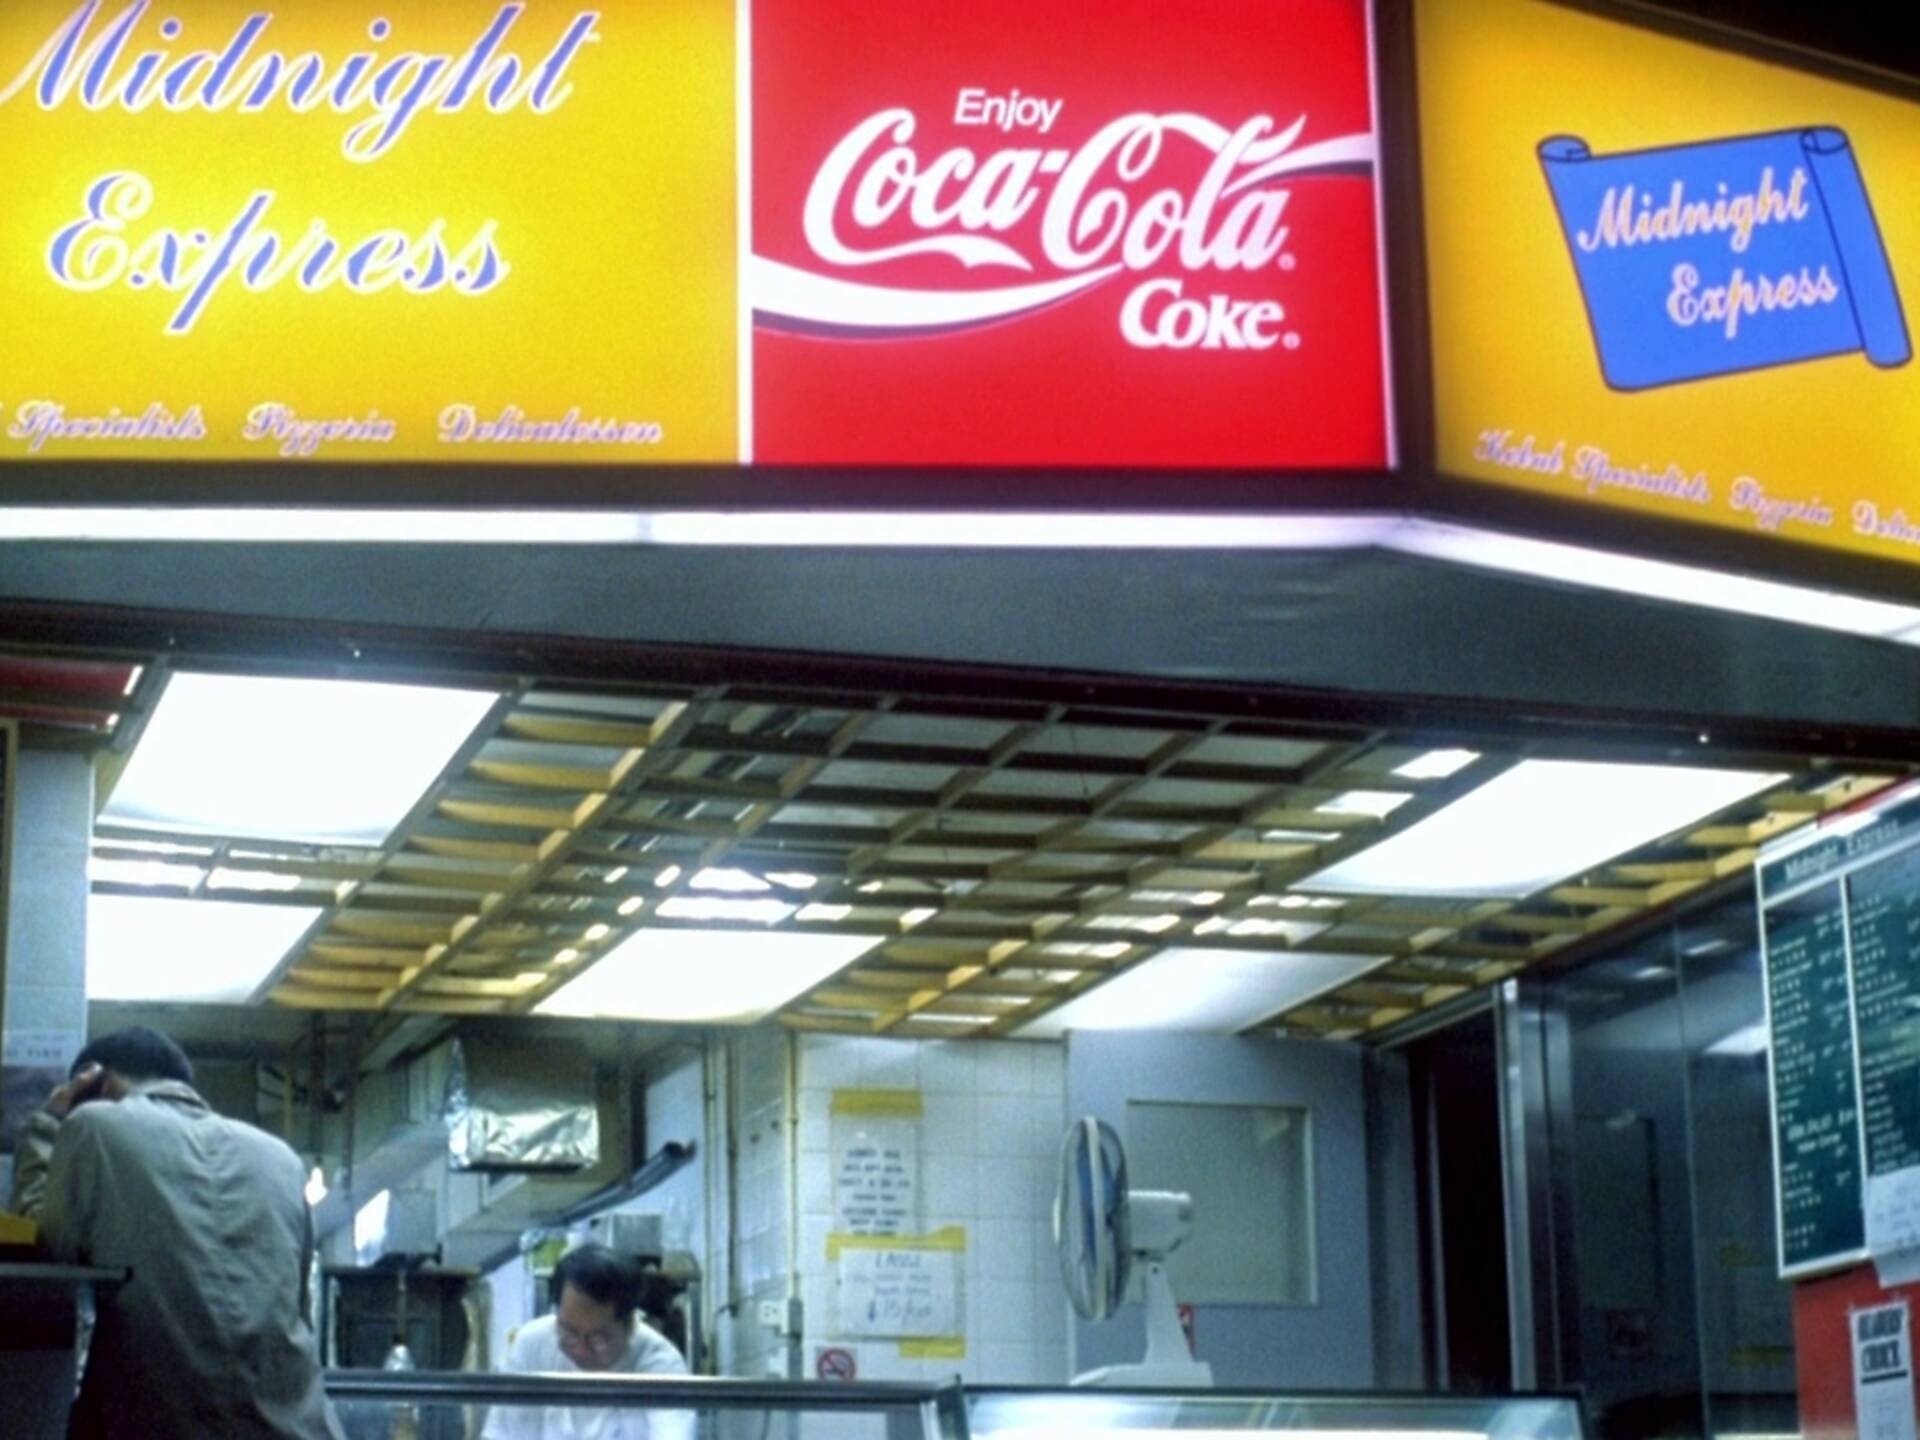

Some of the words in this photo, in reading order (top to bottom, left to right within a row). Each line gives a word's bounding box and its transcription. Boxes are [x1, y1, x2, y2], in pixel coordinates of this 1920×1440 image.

[0, 0, 600, 161] Midnight
[954, 88, 1064, 134] Enjoy
[803, 108, 1306, 272] Coca-Cola
[1577, 165, 1808, 253] Midnight
[45, 170, 510, 335] Express
[1119, 279, 1285, 350] Coke
[1665, 262, 1838, 340] Express
[242, 400, 396, 457] Pizzeria
[437, 401, 664, 445] Delicatessen
[1728, 474, 1834, 531] Pizzeria
